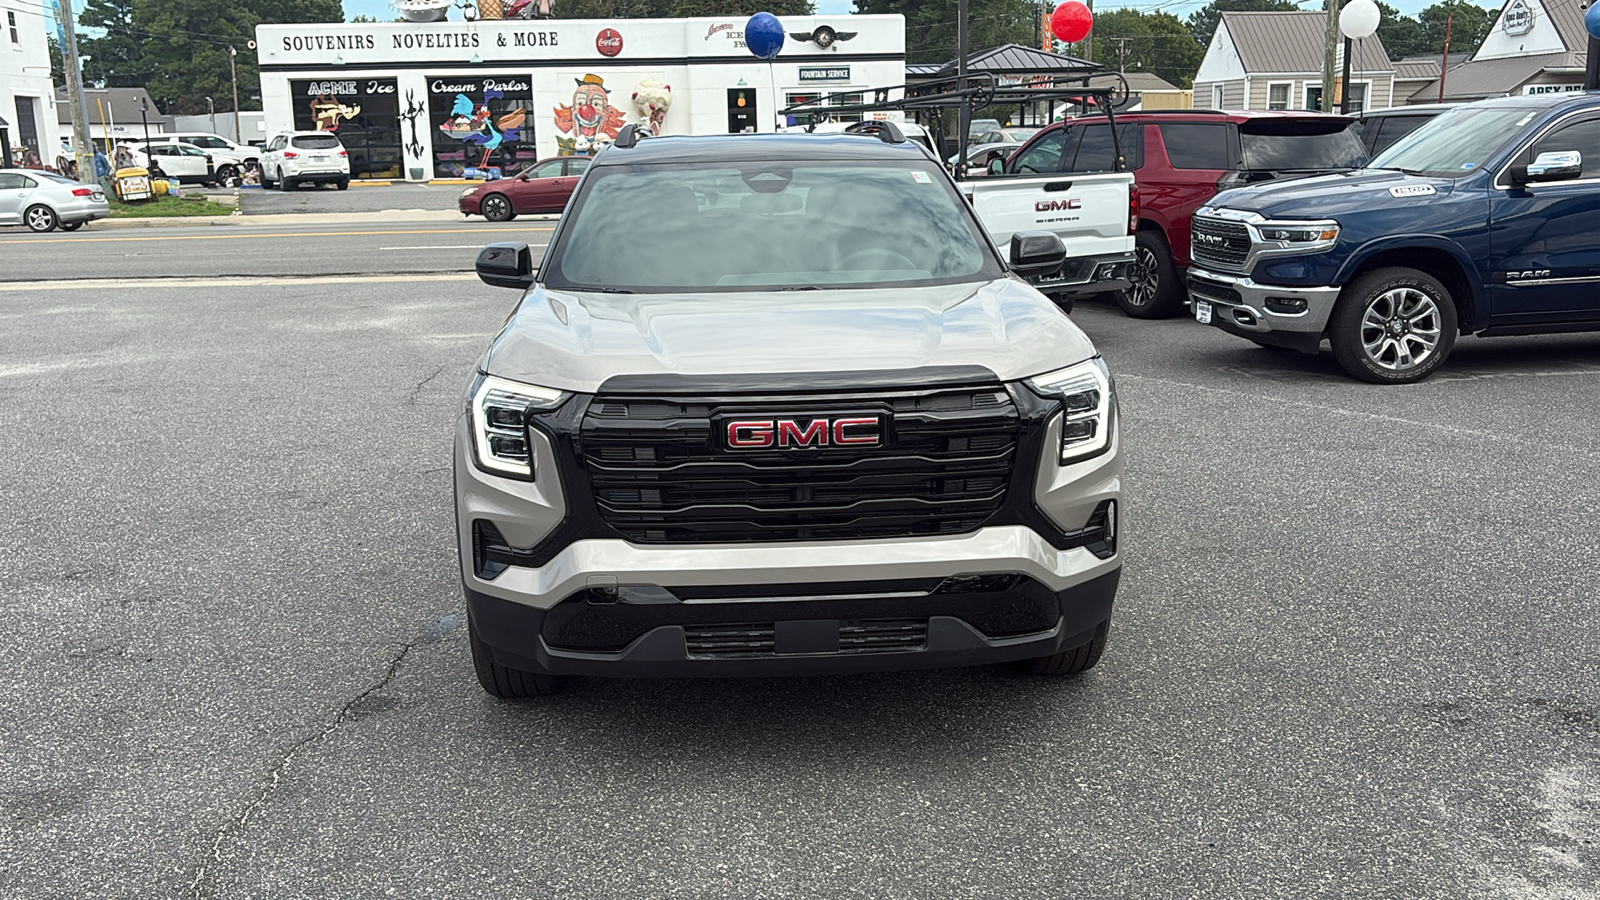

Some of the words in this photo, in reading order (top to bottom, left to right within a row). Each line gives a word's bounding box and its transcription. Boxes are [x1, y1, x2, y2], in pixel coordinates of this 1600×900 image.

[283, 35, 375, 51] SOUVENIRS
[392, 33, 480, 49] NOVELTIES
[496, 32, 507, 47] &
[514, 31, 558, 47] MORE
[725, 31, 744, 39] ICE
[733, 40, 749, 48] PA
[801, 70, 827, 78] FOUNTAIN
[827, 69, 848, 77] SERVICE
[307, 81, 358, 95] ACME
[366, 80, 396, 94] Ice
[431, 79, 477, 93] Cream
[482, 78, 530, 92] Parlor
[1035, 199, 1081, 212] GMC
[1198, 233, 1223, 244] RAM
[1506, 269, 1551, 279] RAM
[727, 416, 880, 448] GMC
